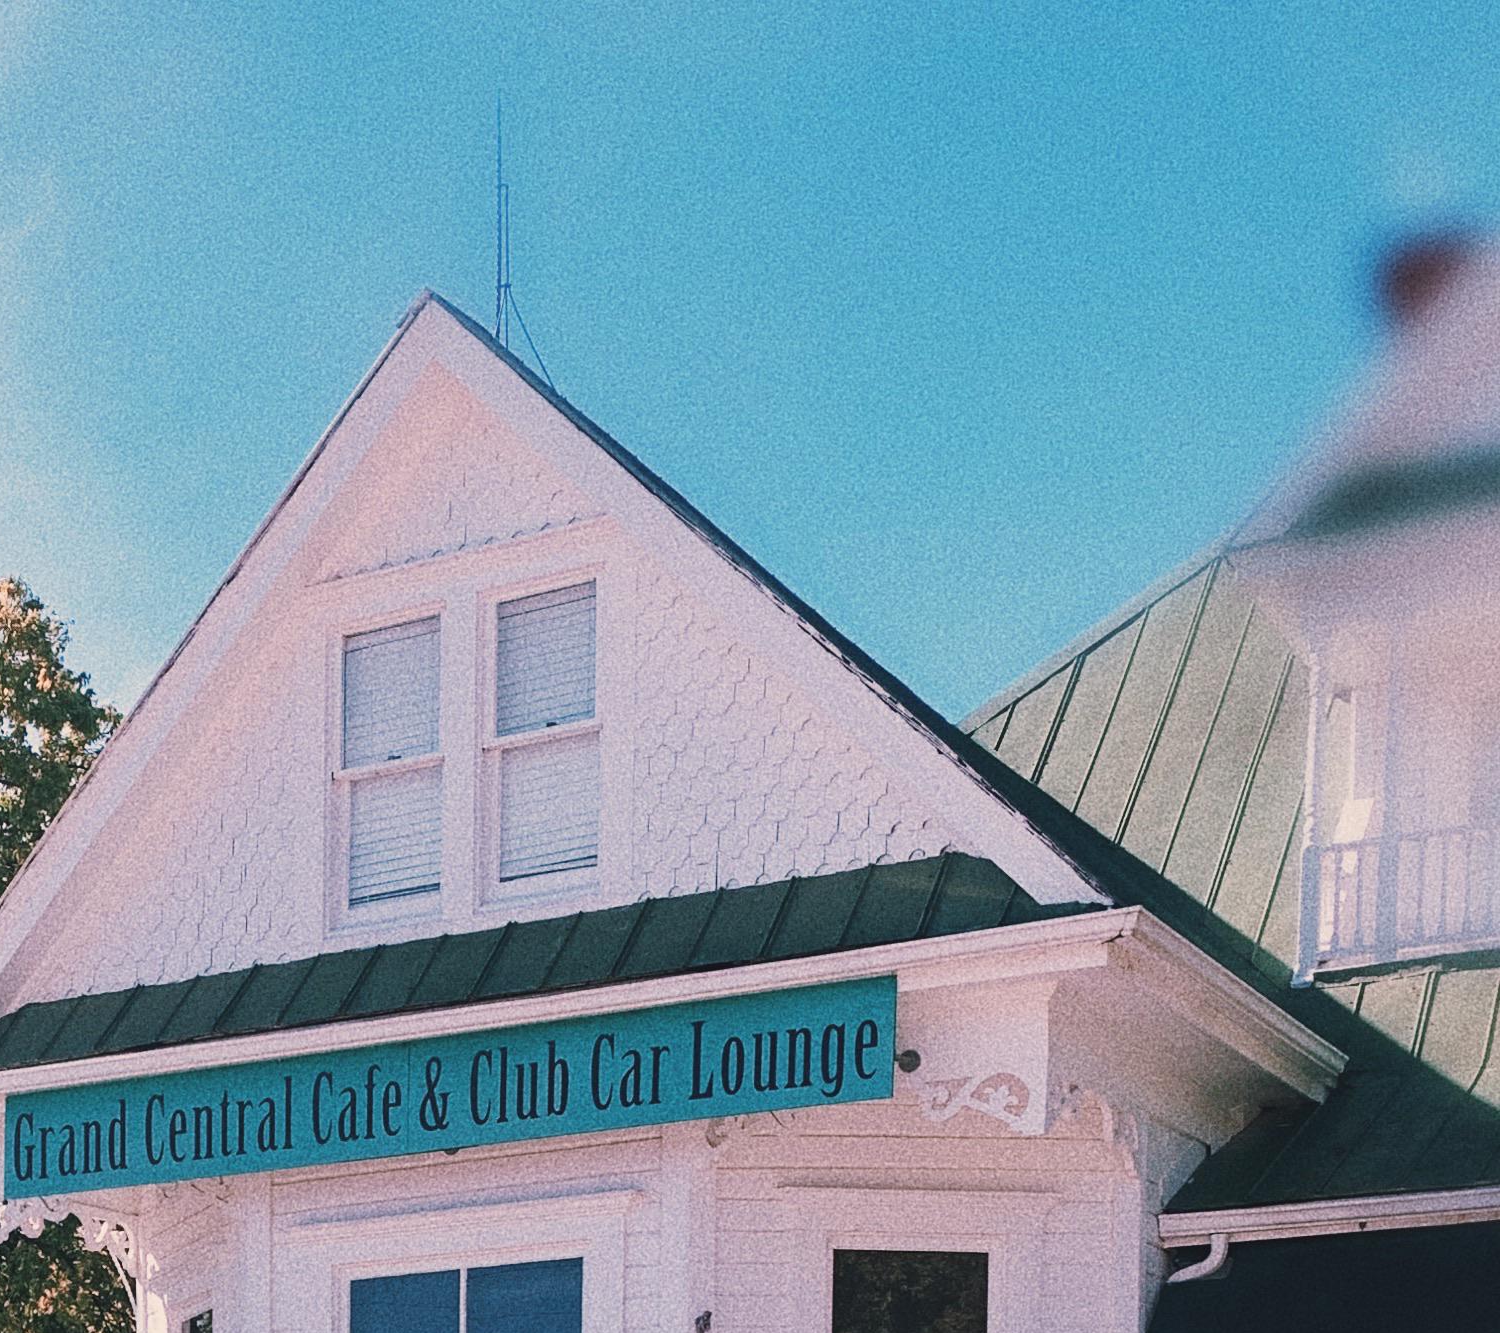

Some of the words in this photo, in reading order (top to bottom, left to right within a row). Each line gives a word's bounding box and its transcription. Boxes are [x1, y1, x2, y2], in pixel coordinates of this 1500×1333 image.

[13, 1096, 128, 1182] Grand
[144, 1073, 294, 1166] Central
[311, 1063, 402, 1146] Cafe
[418, 1055, 451, 1132] &
[469, 1037, 570, 1126] Club
[590, 1032, 671, 1111] Car
[687, 1018, 879, 1106] Lounge
